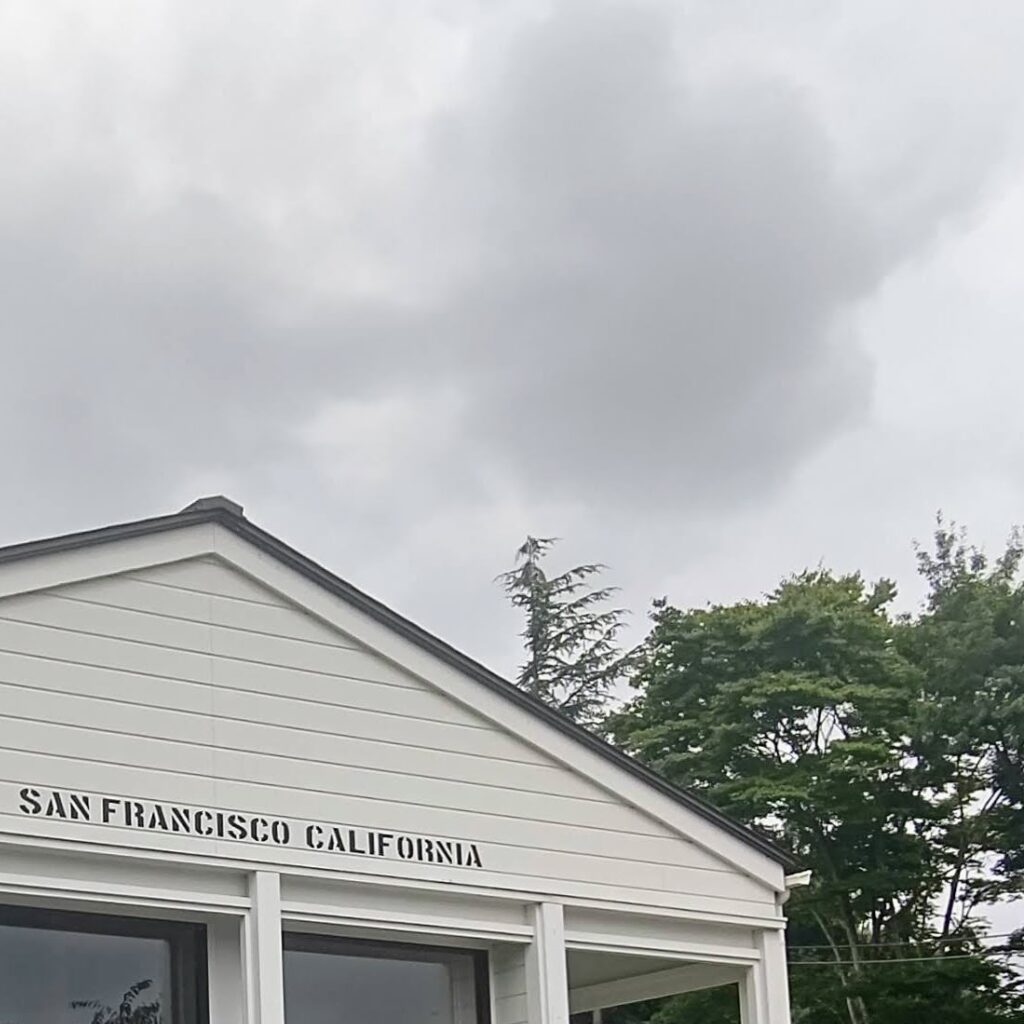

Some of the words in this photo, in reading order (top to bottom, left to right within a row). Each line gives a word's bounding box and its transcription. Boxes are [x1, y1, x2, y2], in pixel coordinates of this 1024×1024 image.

[18, 787, 91, 823] SAN
[101, 798, 290, 845] FRANCISCO
[305, 824, 483, 868] CALIFORNIA
